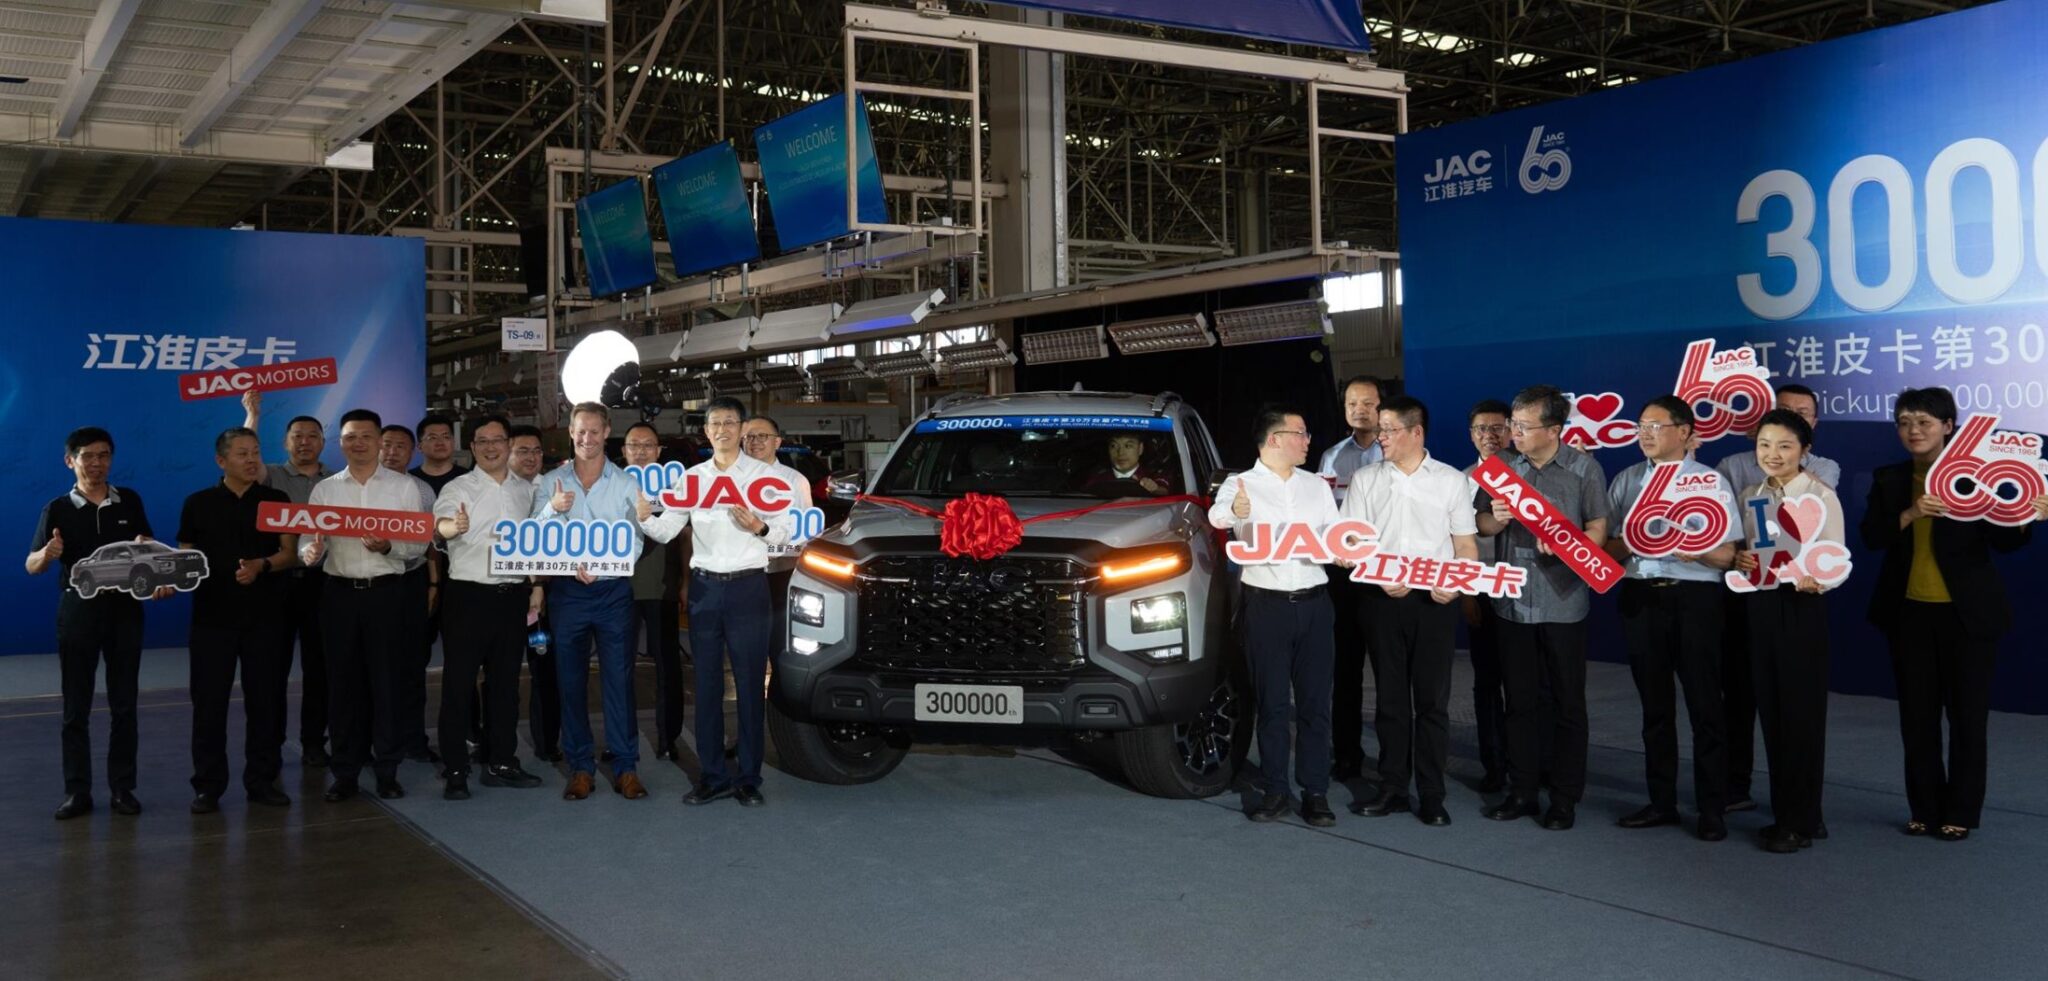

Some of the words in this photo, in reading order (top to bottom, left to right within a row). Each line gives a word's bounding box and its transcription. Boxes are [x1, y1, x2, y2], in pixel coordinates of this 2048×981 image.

[784, 126, 838, 158] WELCOME
[1543, 132, 1565, 143] JAC
[1424, 150, 1492, 183] JAC
[676, 171, 718, 196] WELCOME
[1425, 176, 1493, 202] 江淮汽车
[1736, 137, 2048, 320] 300
[82, 333, 296, 371] 江淮皮卡
[1712, 349, 1752, 366] JAC
[188, 372, 253, 396] JAC
[256, 364, 330, 386] MOTORS
[1938, 380, 2048, 413] 00,00
[1989, 445, 2015, 454] SINCE
[2018, 448, 2037, 456] 1964
[1991, 434, 2038, 448] JAC
[661, 475, 792, 511] JAC
[1675, 485, 1698, 494] SINCE
[1676, 474, 1717, 486] JAC
[266, 508, 341, 531] JAC
[344, 515, 426, 534] MOTORS
[1482, 470, 1544, 521] JAC
[1538, 516, 1613, 582] MOTORS
[494, 520, 633, 558] 300000
[1229, 521, 1378, 561] JAC
[1354, 553, 1524, 596] 江淮皮卡
[1728, 544, 1848, 588] JAC
